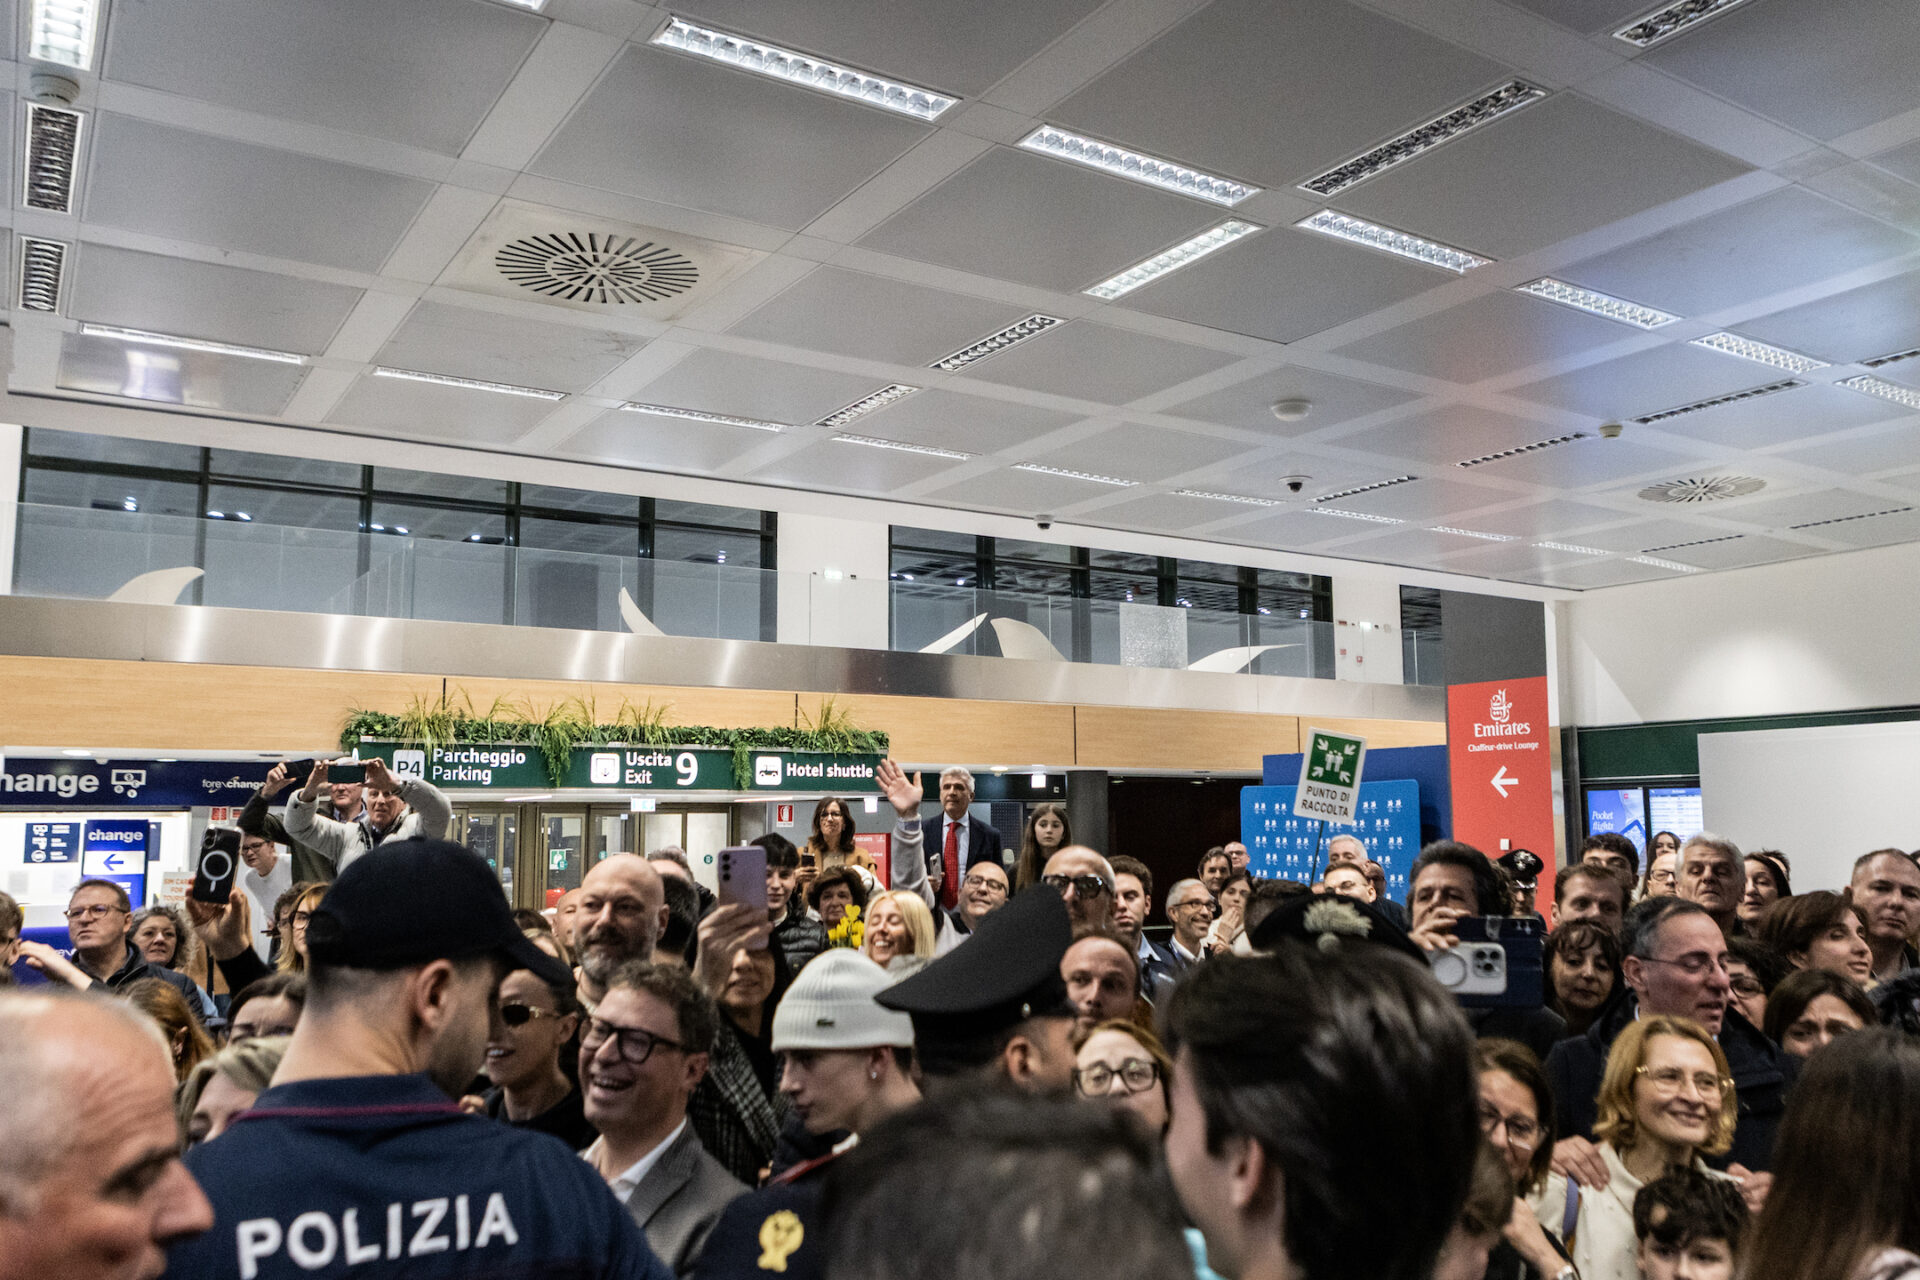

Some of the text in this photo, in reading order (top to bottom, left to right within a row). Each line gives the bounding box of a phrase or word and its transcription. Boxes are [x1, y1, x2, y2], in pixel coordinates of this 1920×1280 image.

[1473, 721, 1531, 738] Emirates
[1514, 741, 1539, 751] Lounge
[432, 748, 526, 768] Parcheggio
[626, 751, 672, 767] Uscita
[397, 760, 421, 777] P4
[432, 765, 492, 785] Parking
[625, 769, 653, 784] Exit
[675, 752, 699, 786] 9
[786, 762, 873, 778] Hotel shuttle
[1306, 785, 1350, 802] PUNTO DI
[1301, 799, 1349, 817] RACCOLTA
[88, 829, 144, 843] change
[235, 1192, 519, 1280] POLIZIA
